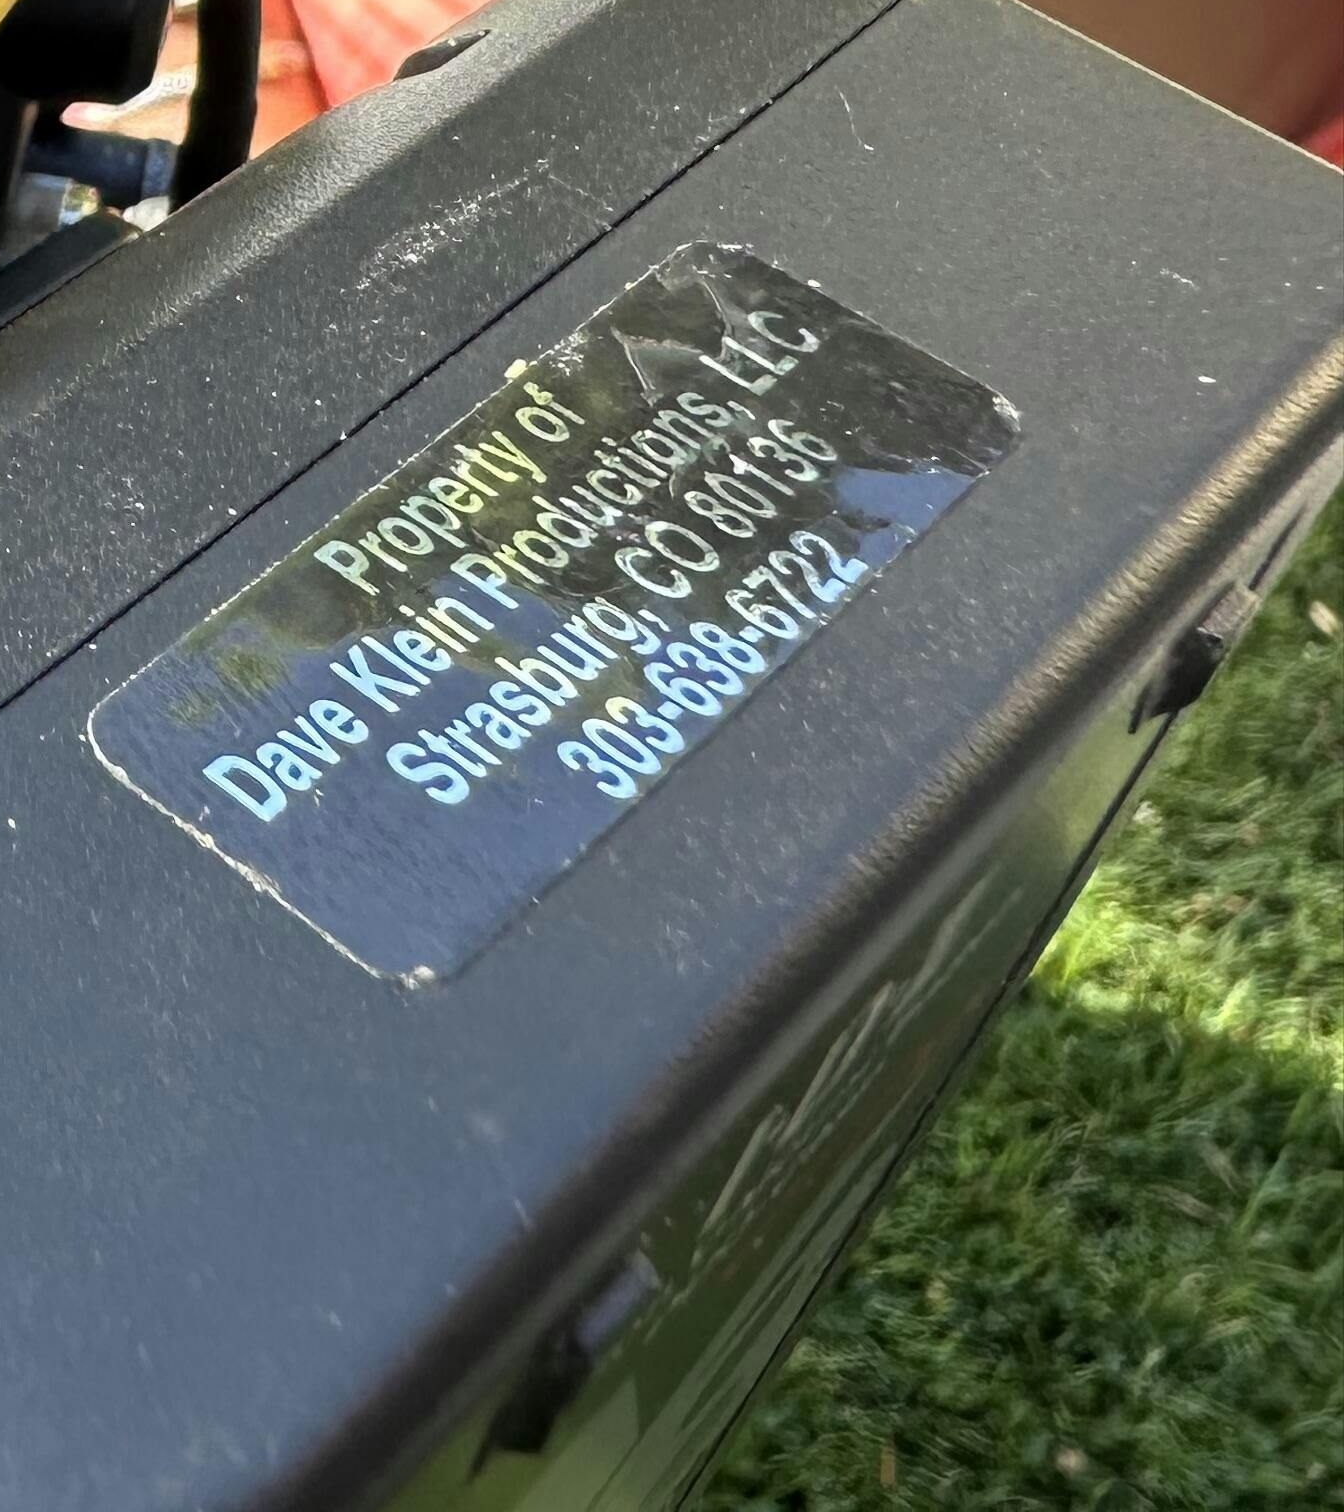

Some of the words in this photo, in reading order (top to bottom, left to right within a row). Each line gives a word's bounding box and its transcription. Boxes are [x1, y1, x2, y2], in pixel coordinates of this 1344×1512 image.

[201, 696, 370, 823] Dave
[329, 578, 500, 714] Klein
[448, 390, 757, 610] Productions,
[699, 308, 822, 396] LLC
[313, 422, 548, 596] Property
[520, 379, 587, 444] of
[385, 595, 671, 806] Strasburg,
[614, 519, 720, 600] CO
[685, 418, 839, 540] 80136
[555, 528, 869, 801] 303-638-6722
